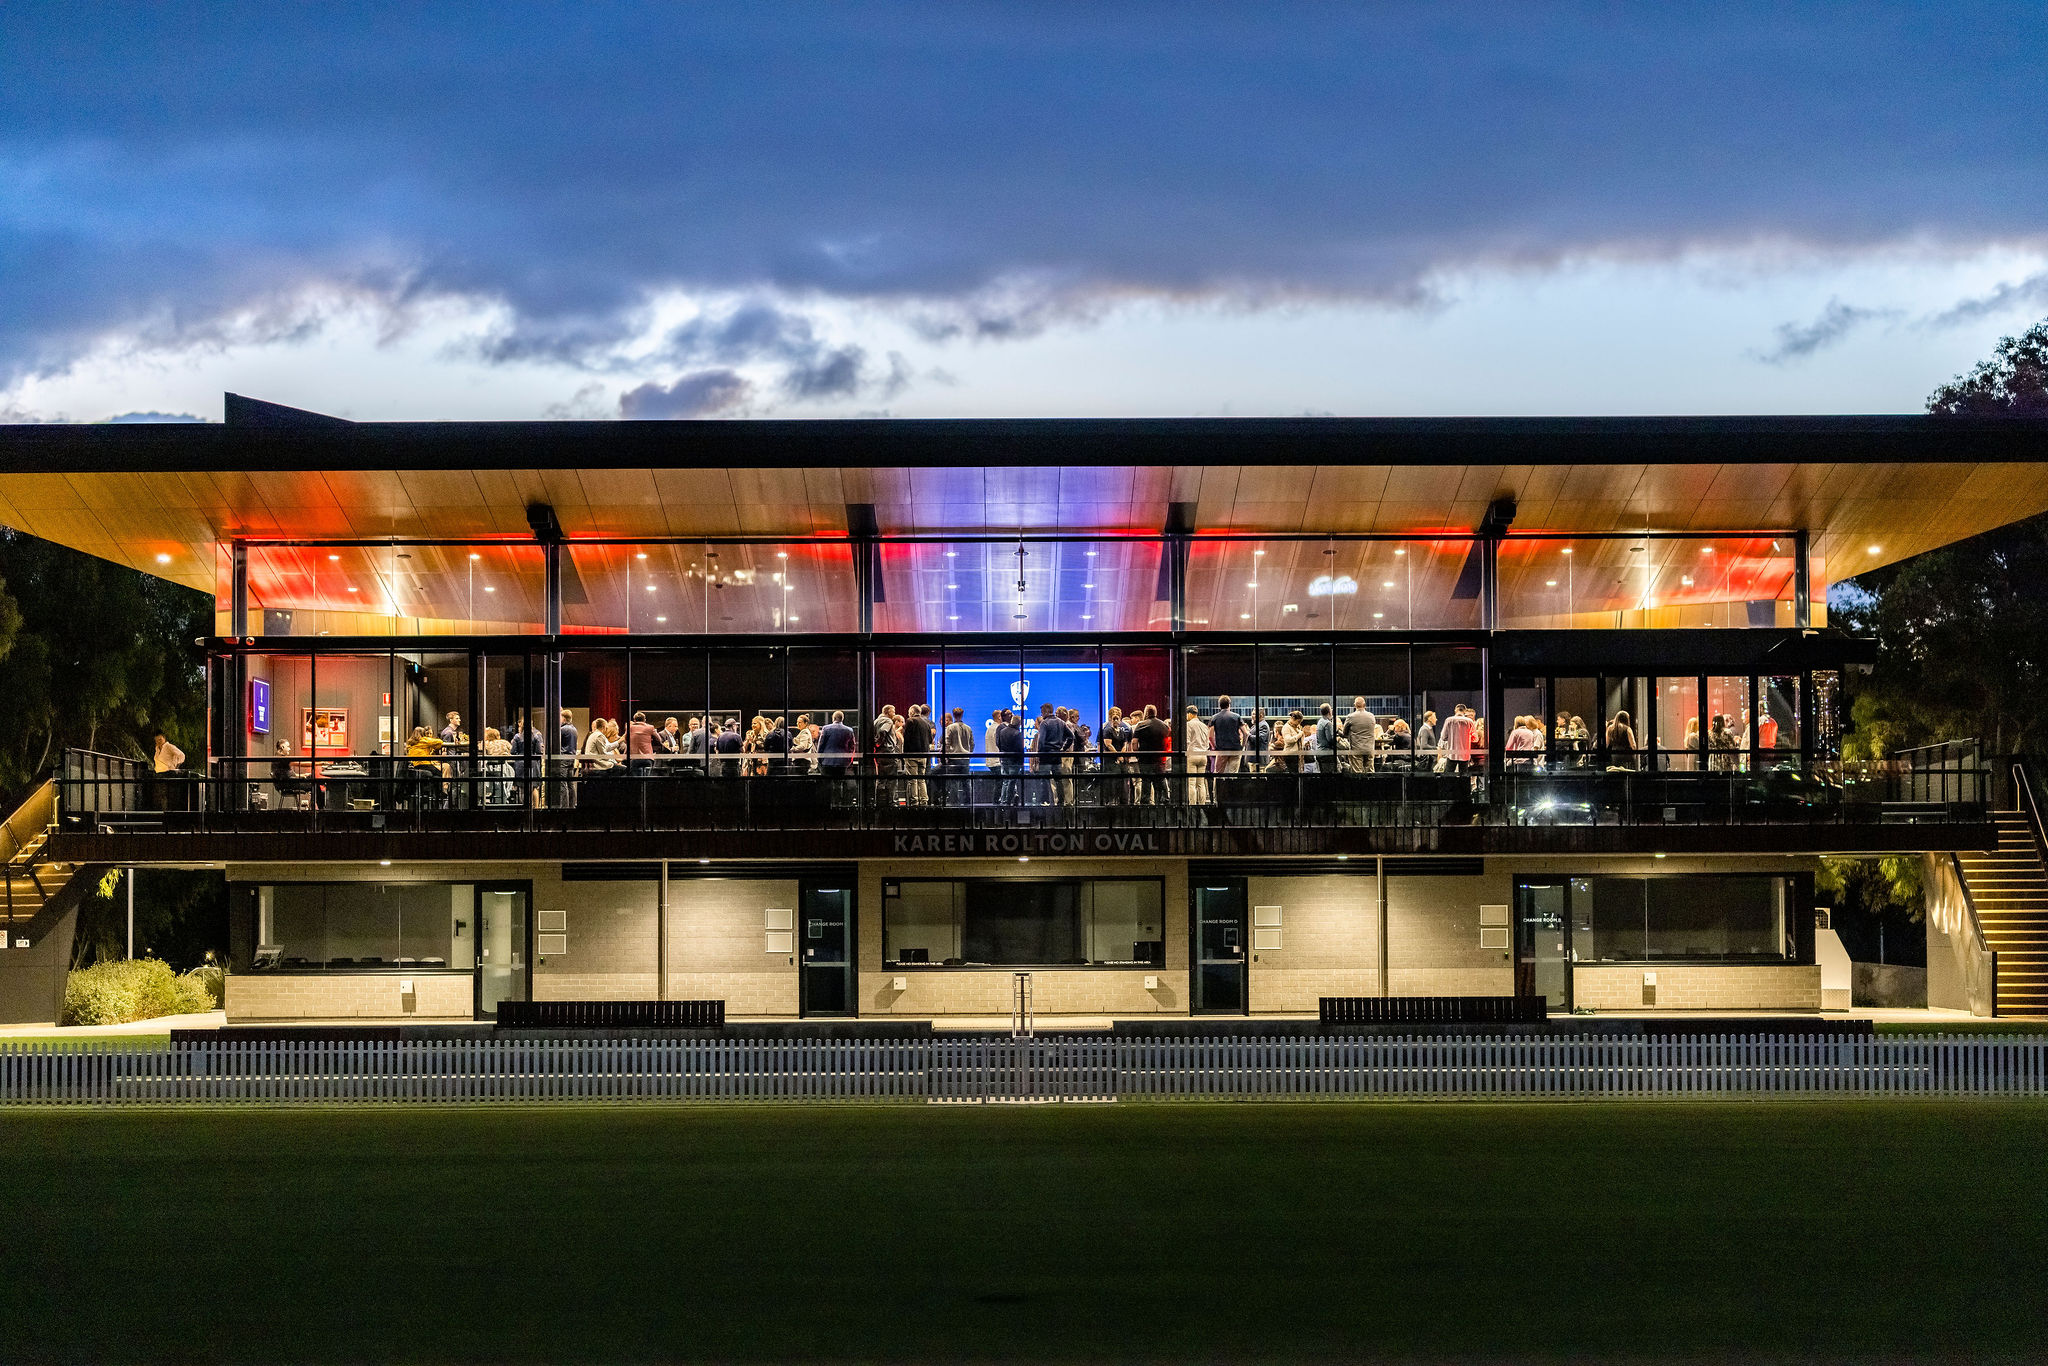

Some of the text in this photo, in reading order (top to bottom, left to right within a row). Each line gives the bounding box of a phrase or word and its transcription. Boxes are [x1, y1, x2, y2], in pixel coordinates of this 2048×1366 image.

[894, 833, 1159, 852] KAREN ROLTON OVAL
